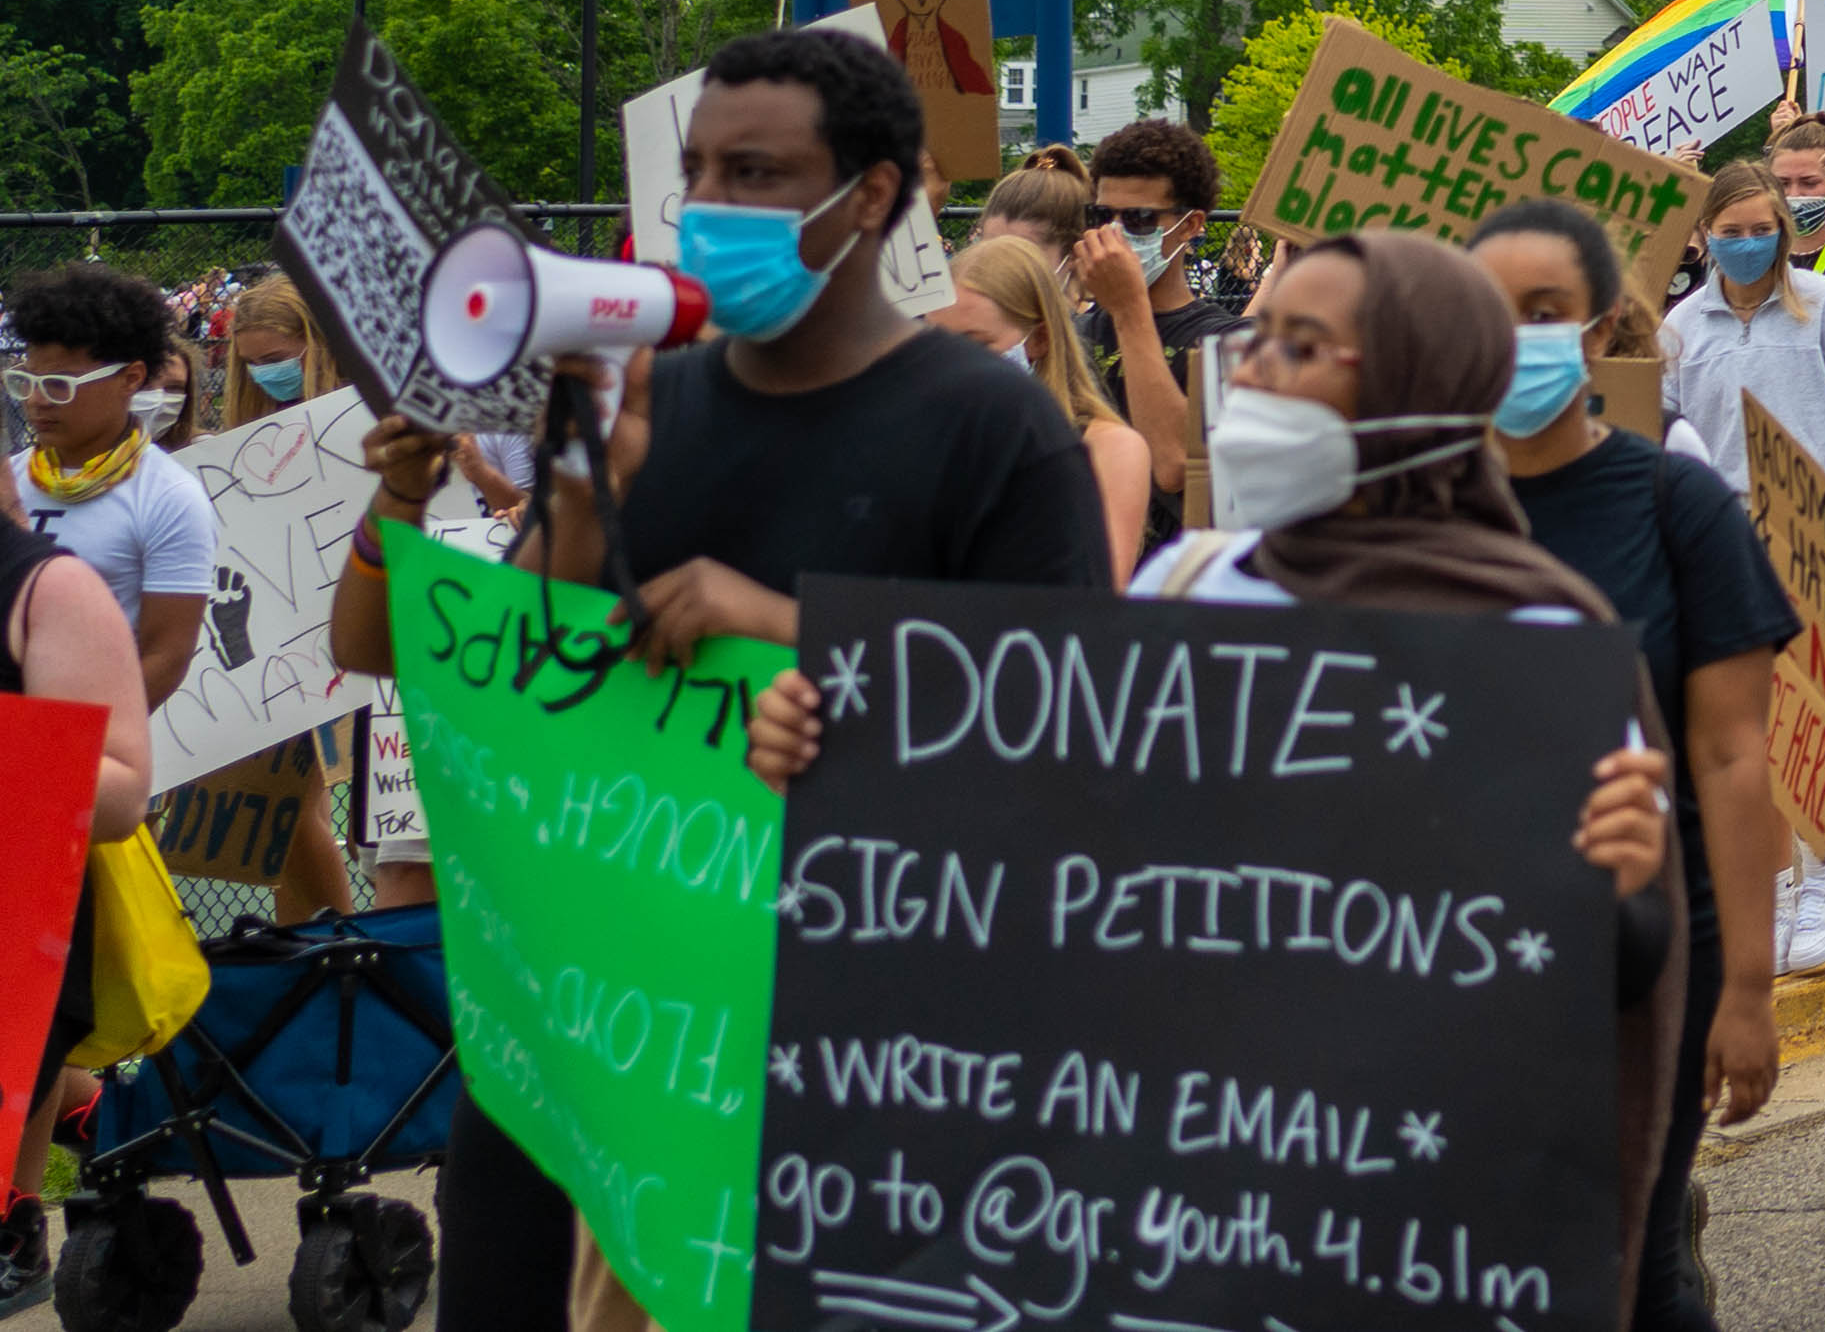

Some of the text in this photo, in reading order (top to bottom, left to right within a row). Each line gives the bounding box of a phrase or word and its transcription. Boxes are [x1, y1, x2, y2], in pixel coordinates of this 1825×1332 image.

[1331, 66, 1412, 130] all
[1599, 80, 1657, 139] EOPLE
[1668, 20, 1745, 94] WANT
[1039, 1049, 1140, 1136] AN
[766, 1153, 855, 1263] go
[870, 1149, 943, 1234] to
